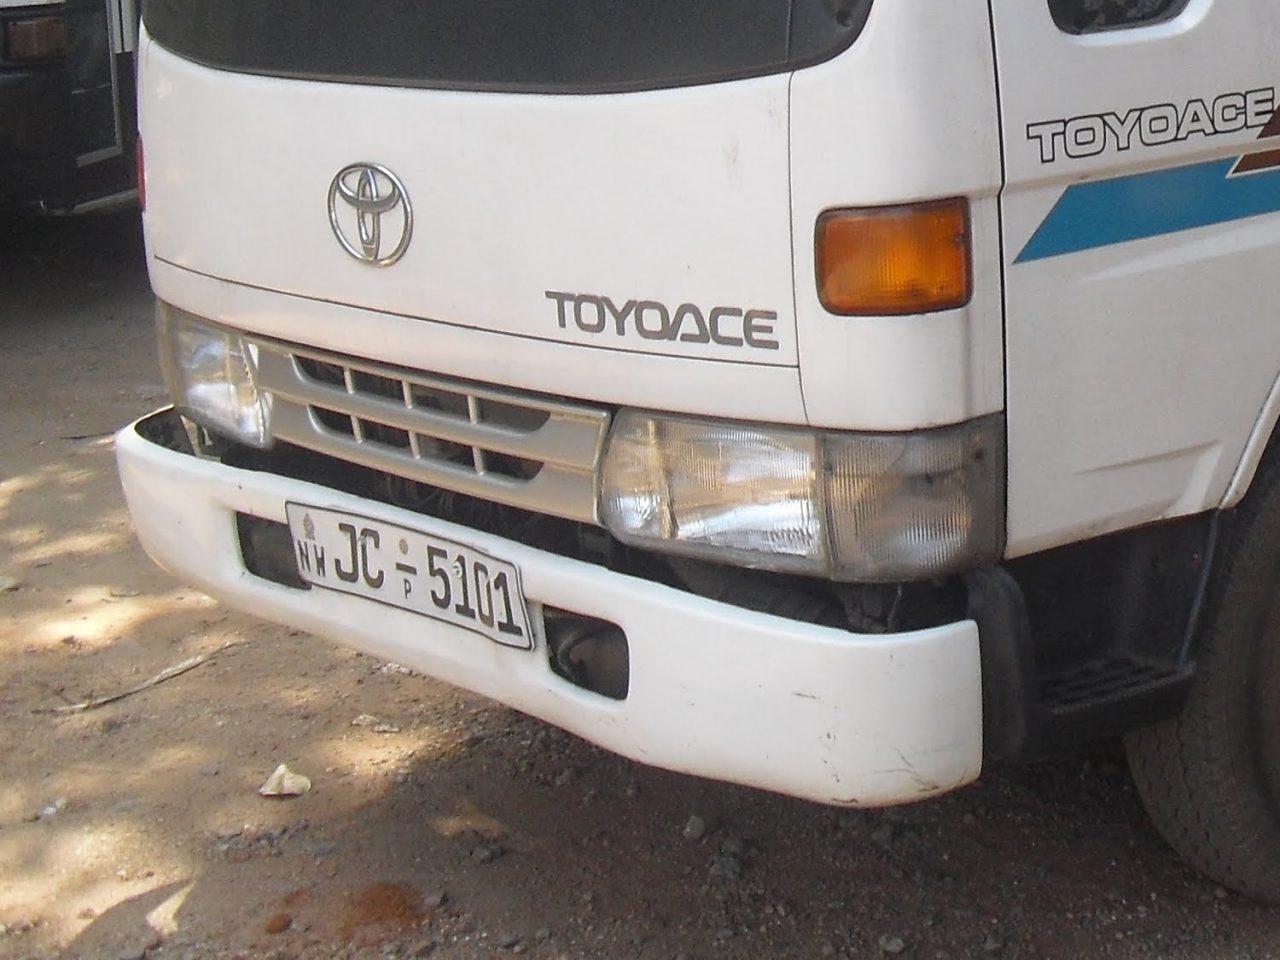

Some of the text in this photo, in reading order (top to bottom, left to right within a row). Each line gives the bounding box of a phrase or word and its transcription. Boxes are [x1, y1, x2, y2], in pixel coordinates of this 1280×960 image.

[1026, 87, 1275, 163] TOYOACE
[545, 291, 779, 349] TOYOACE
[298, 540, 325, 577] NW
[334, 523, 384, 588] JC
[427, 545, 523, 637] 5101
[404, 578, 412, 599] P
